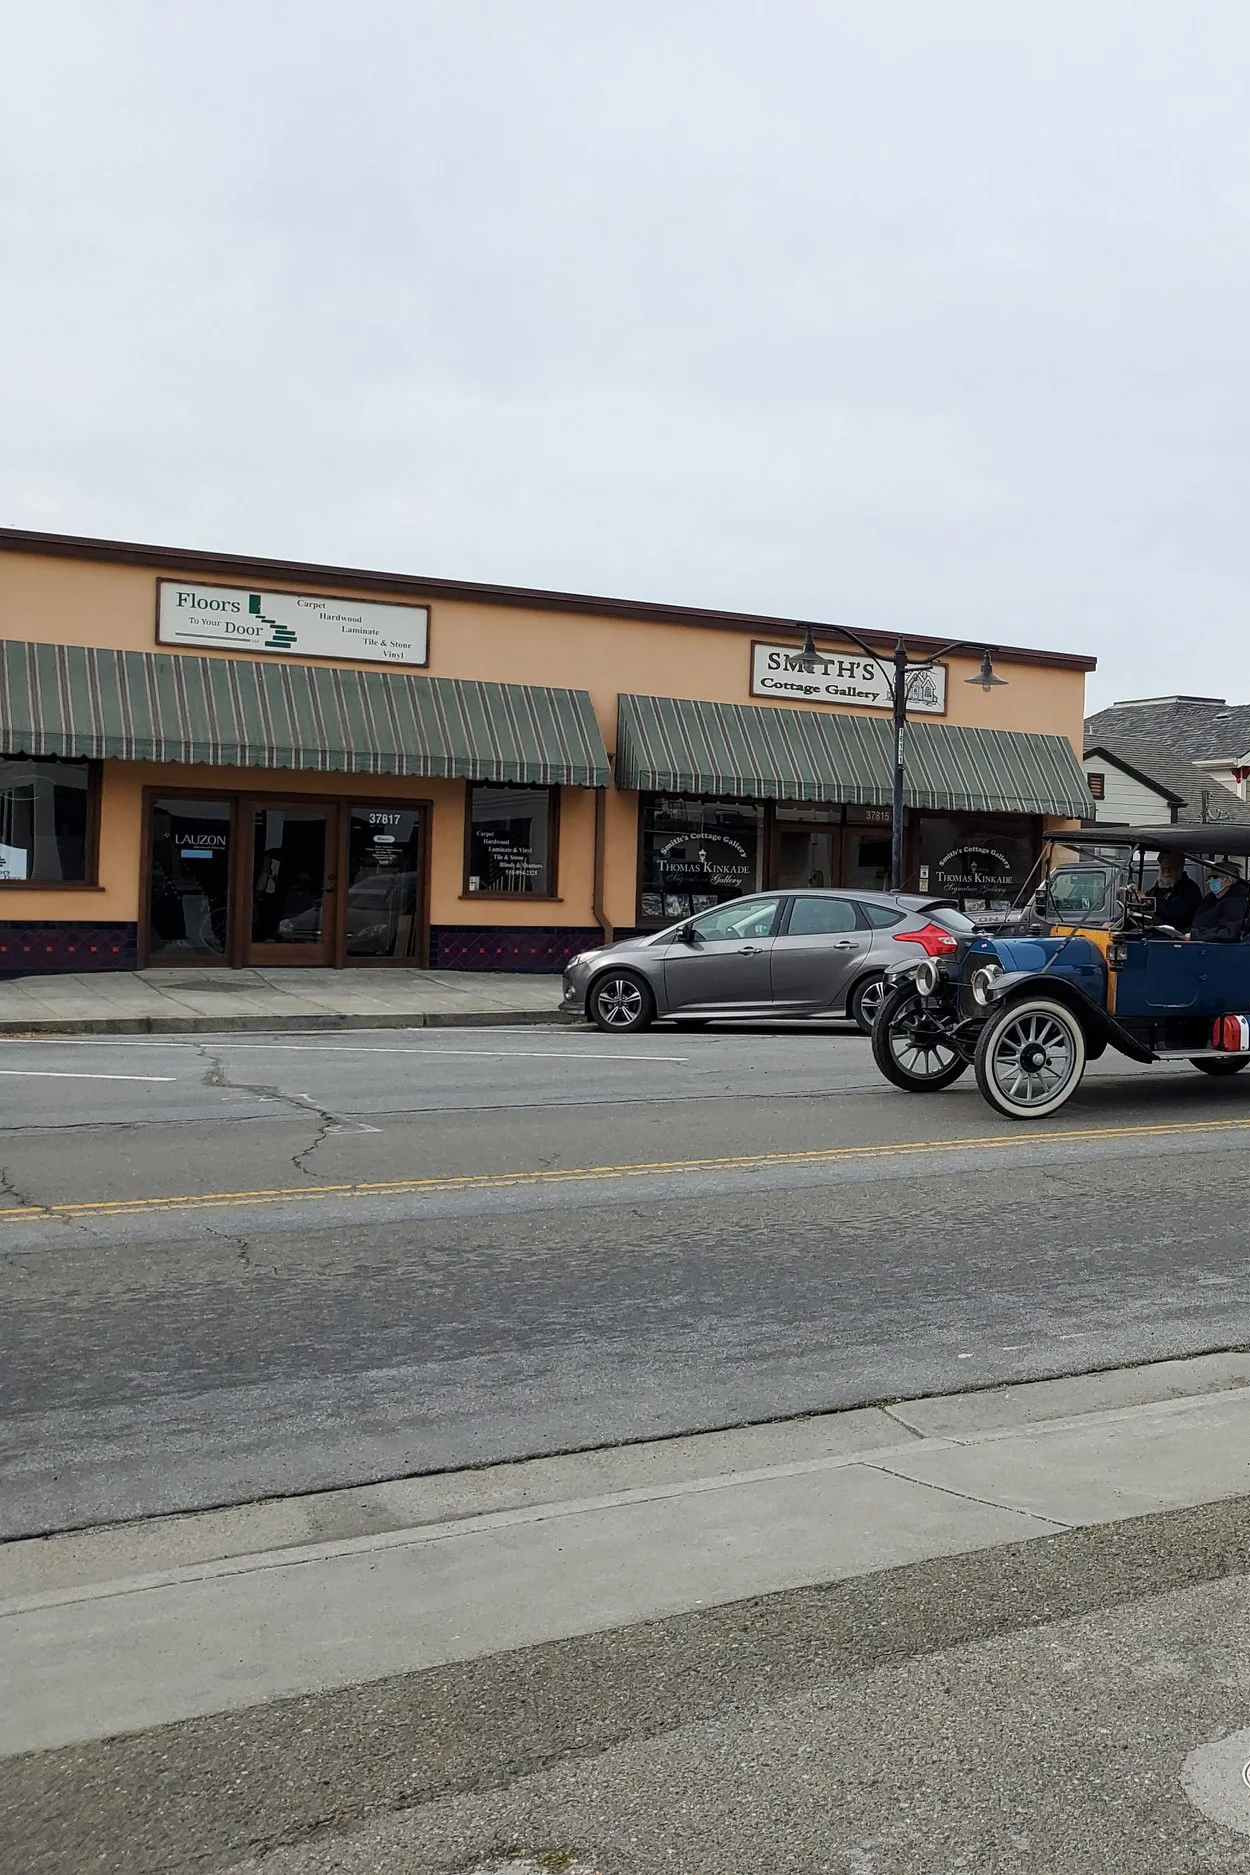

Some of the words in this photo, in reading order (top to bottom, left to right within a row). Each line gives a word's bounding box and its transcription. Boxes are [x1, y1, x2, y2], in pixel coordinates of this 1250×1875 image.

[175, 591, 241, 613] Floors
[297, 599, 326, 610] Carpet
[319, 612, 362, 623] Hardwood
[188, 616, 199, 625] To
[201, 618, 222, 627] Your
[224, 621, 263, 636] Door
[341, 625, 380, 636] Laminate
[363, 638, 378, 647] Tile
[380, 639, 387, 647] &
[390, 640, 412, 649] Stone
[383, 650, 404, 660] Vinyl
[767, 652, 875, 681] SMTH'S
[760, 677, 821, 695] Cottage
[825, 684, 880, 701] Gallery
[369, 813, 400, 825] 37817
[866, 810, 890, 821] 37815
[175, 834, 226, 846] LAUZON
[476, 830, 495, 838] Carpet
[660, 834, 689, 855] Smith's
[690, 832, 721, 841] Cottage
[723, 836, 748, 858] Gallery
[939, 848, 962, 866] Smith's
[963, 846, 989, 854] Cottage
[990, 849, 1011, 869] Gallery
[656, 860, 700, 872] THOMAS
[703, 861, 750, 874] KINKADE
[710, 873, 742, 887] Gallery
[936, 871, 972, 883] THOMAS
[974, 872, 1013, 884] KINKADE
